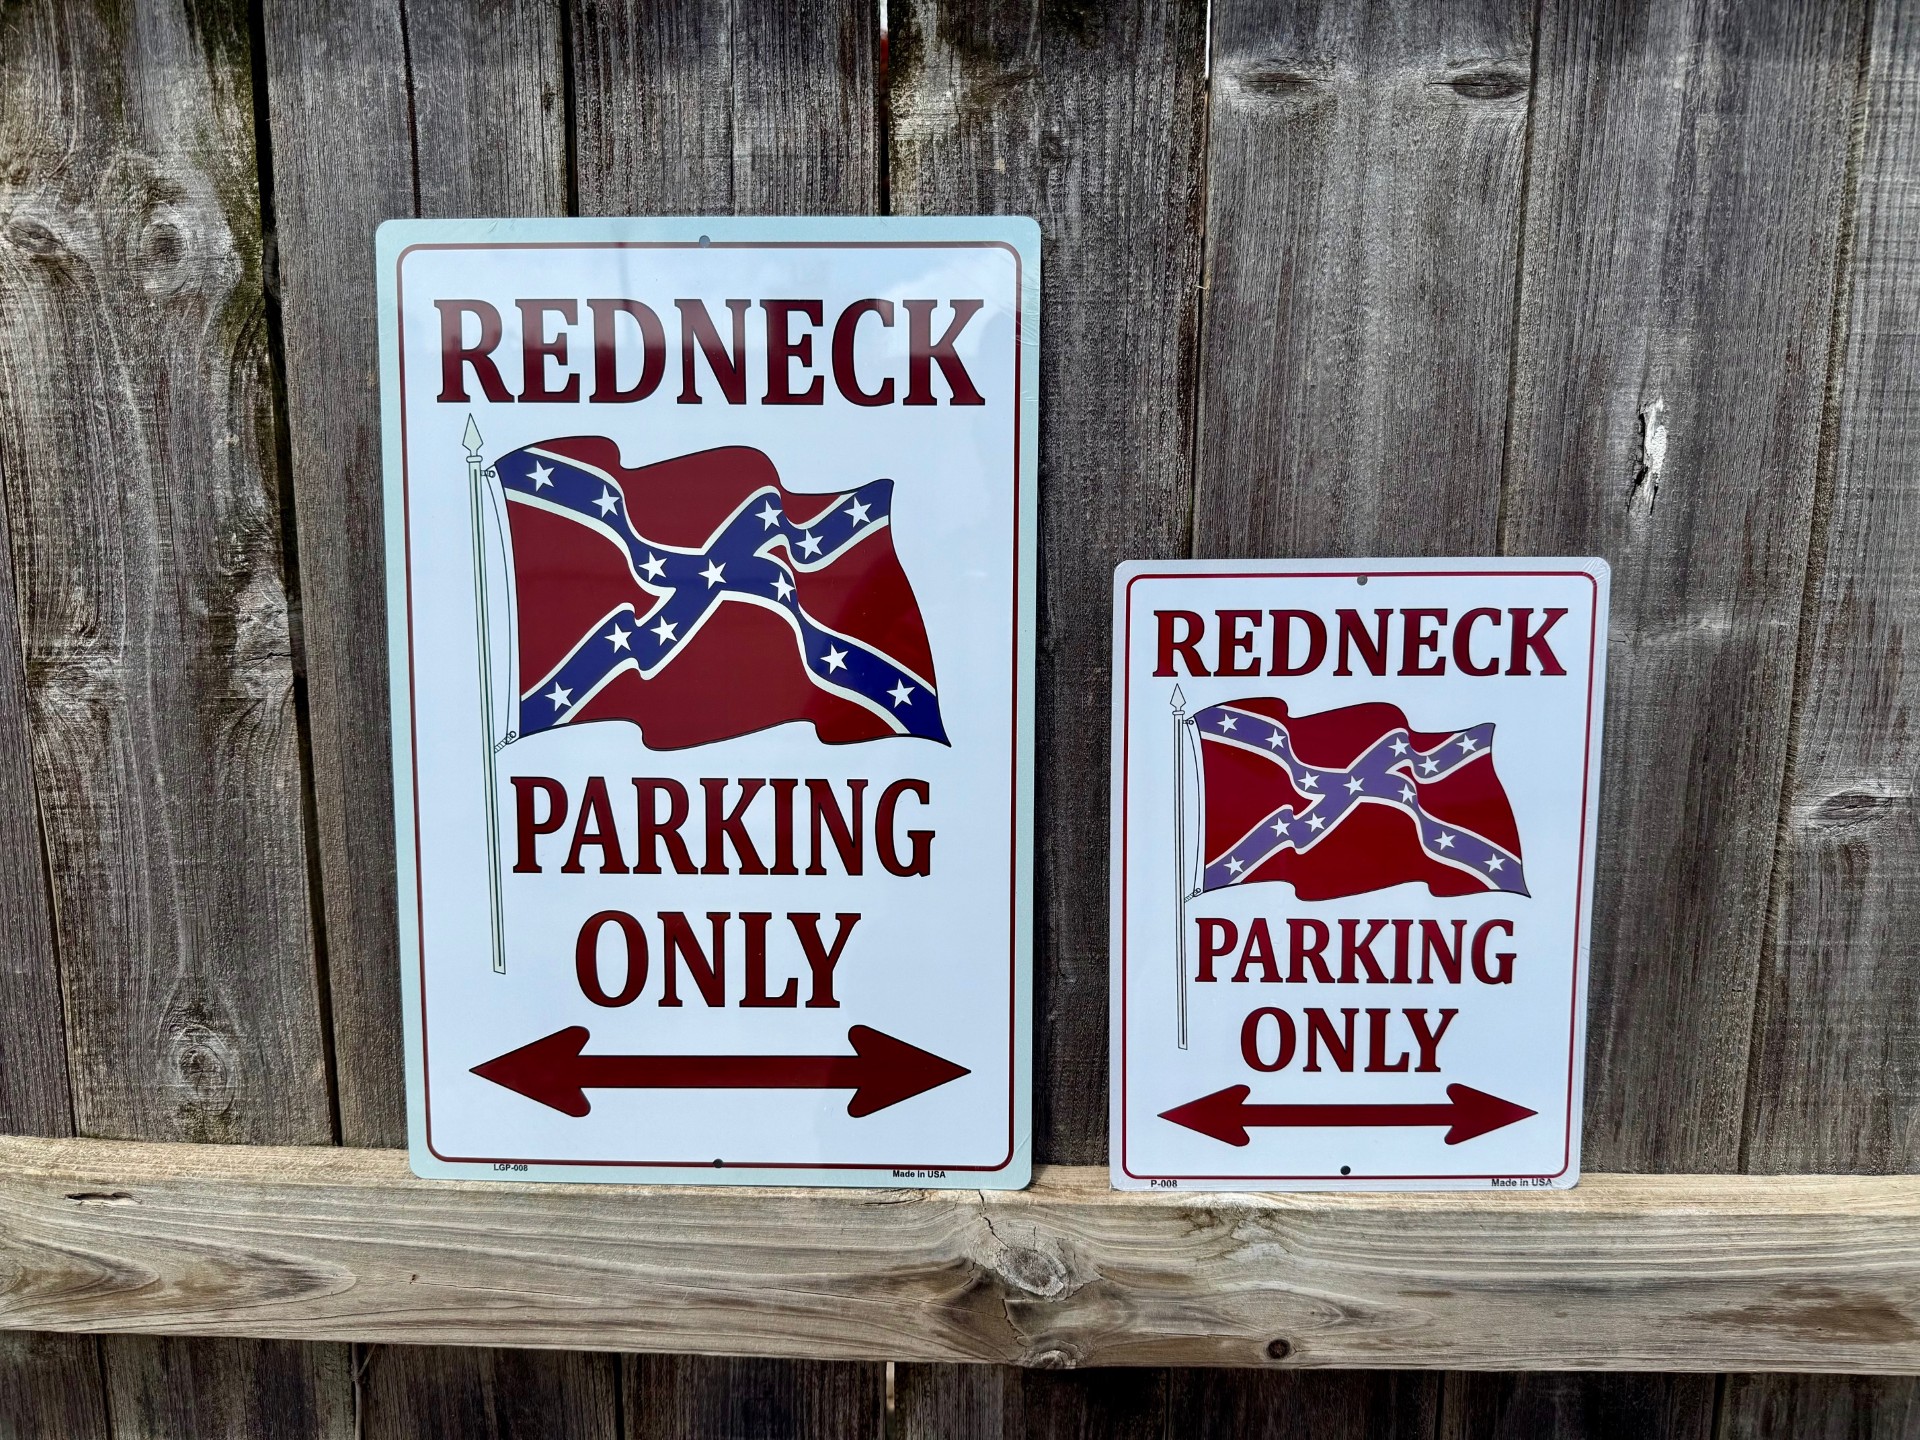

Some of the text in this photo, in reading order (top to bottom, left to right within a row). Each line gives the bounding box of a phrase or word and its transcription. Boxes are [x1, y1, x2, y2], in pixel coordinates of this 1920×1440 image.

[435, 298, 986, 407] REDNECK
[1152, 607, 1569, 678] REDNECK
[510, 776, 936, 878] PARKING
[575, 909, 862, 1009] ONLY
[1194, 917, 1518, 985] PARKING
[1240, 1006, 1459, 1073] ONLY
[493, 1163, 529, 1172] LGP-008
[892, 1169, 915, 1178] Made
[927, 1170, 946, 1179] USA
[1150, 1179, 1178, 1188] P-008
[1491, 1178, 1517, 1187] Made
[1531, 1177, 1553, 1187] USA
